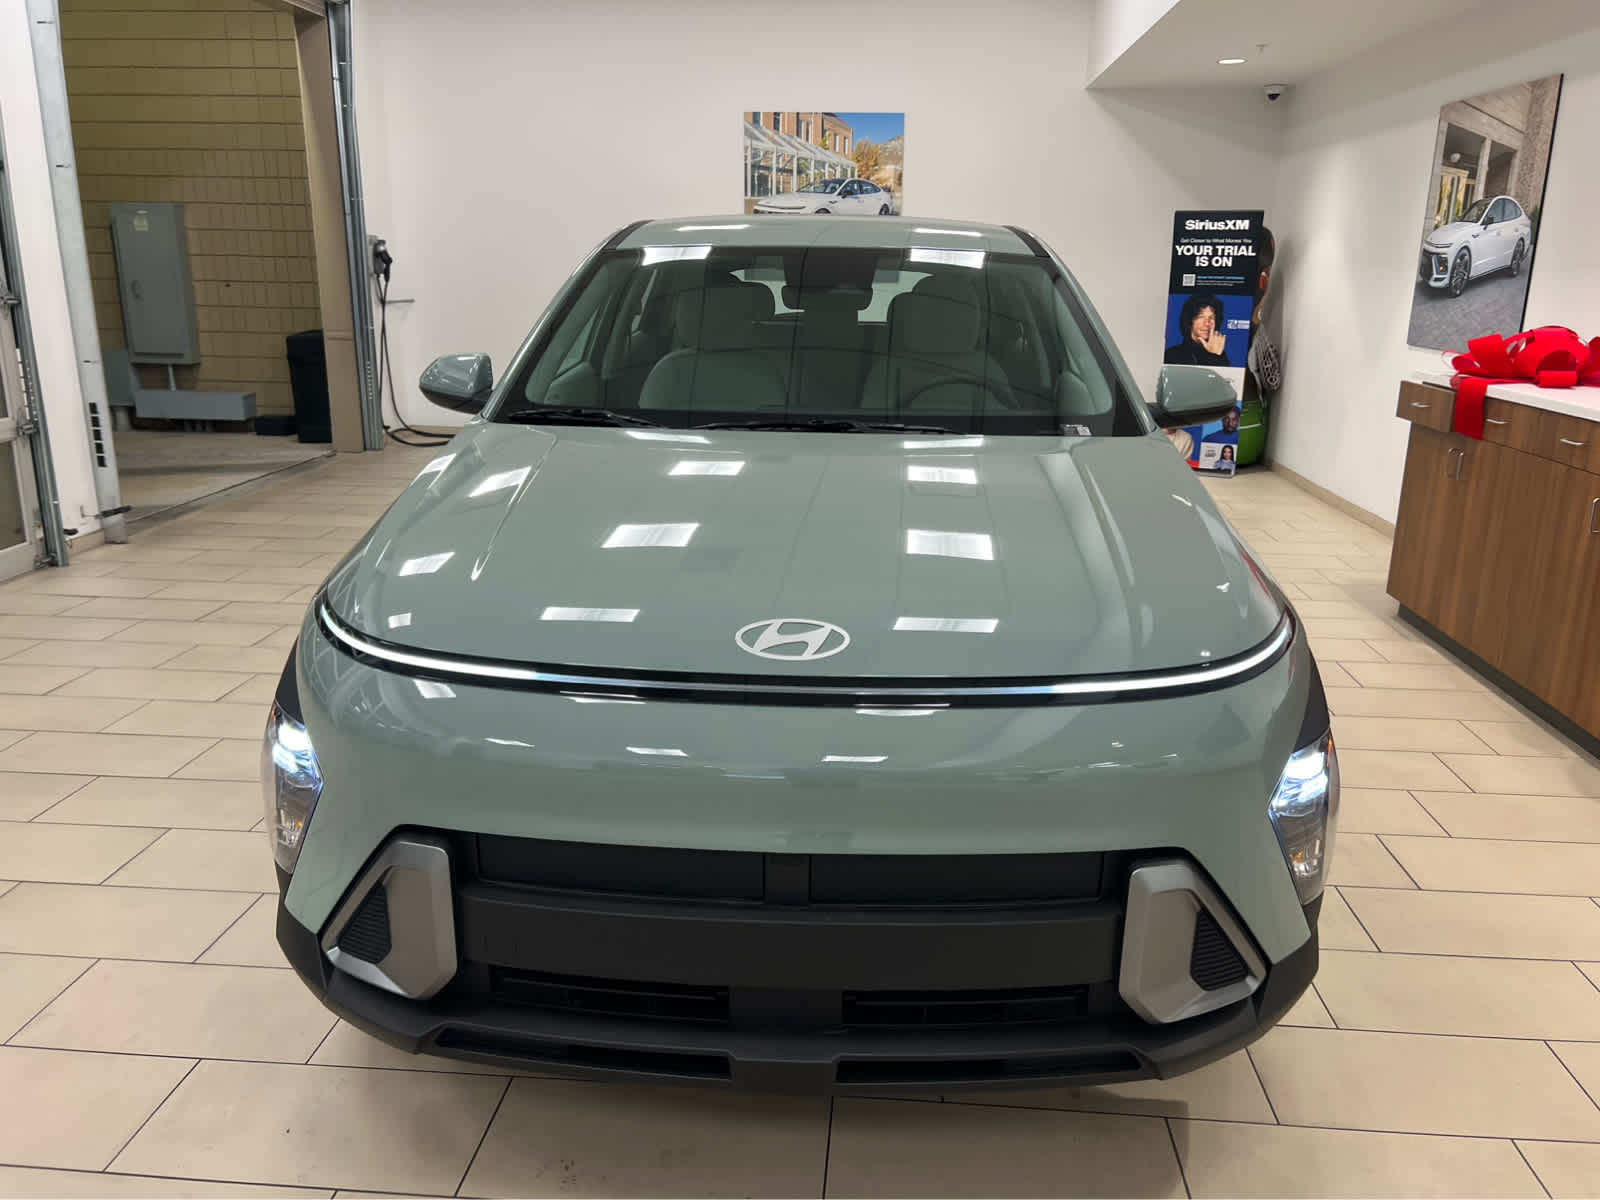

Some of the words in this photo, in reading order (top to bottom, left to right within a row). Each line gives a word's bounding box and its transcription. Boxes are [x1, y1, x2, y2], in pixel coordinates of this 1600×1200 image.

[1185, 219, 1250, 231] SiriusXM
[1175, 245, 1213, 256] YOUR
[1216, 245, 1256, 256] TRIAL
[1195, 256, 1209, 267] IS
[1211, 256, 1232, 267] ON
